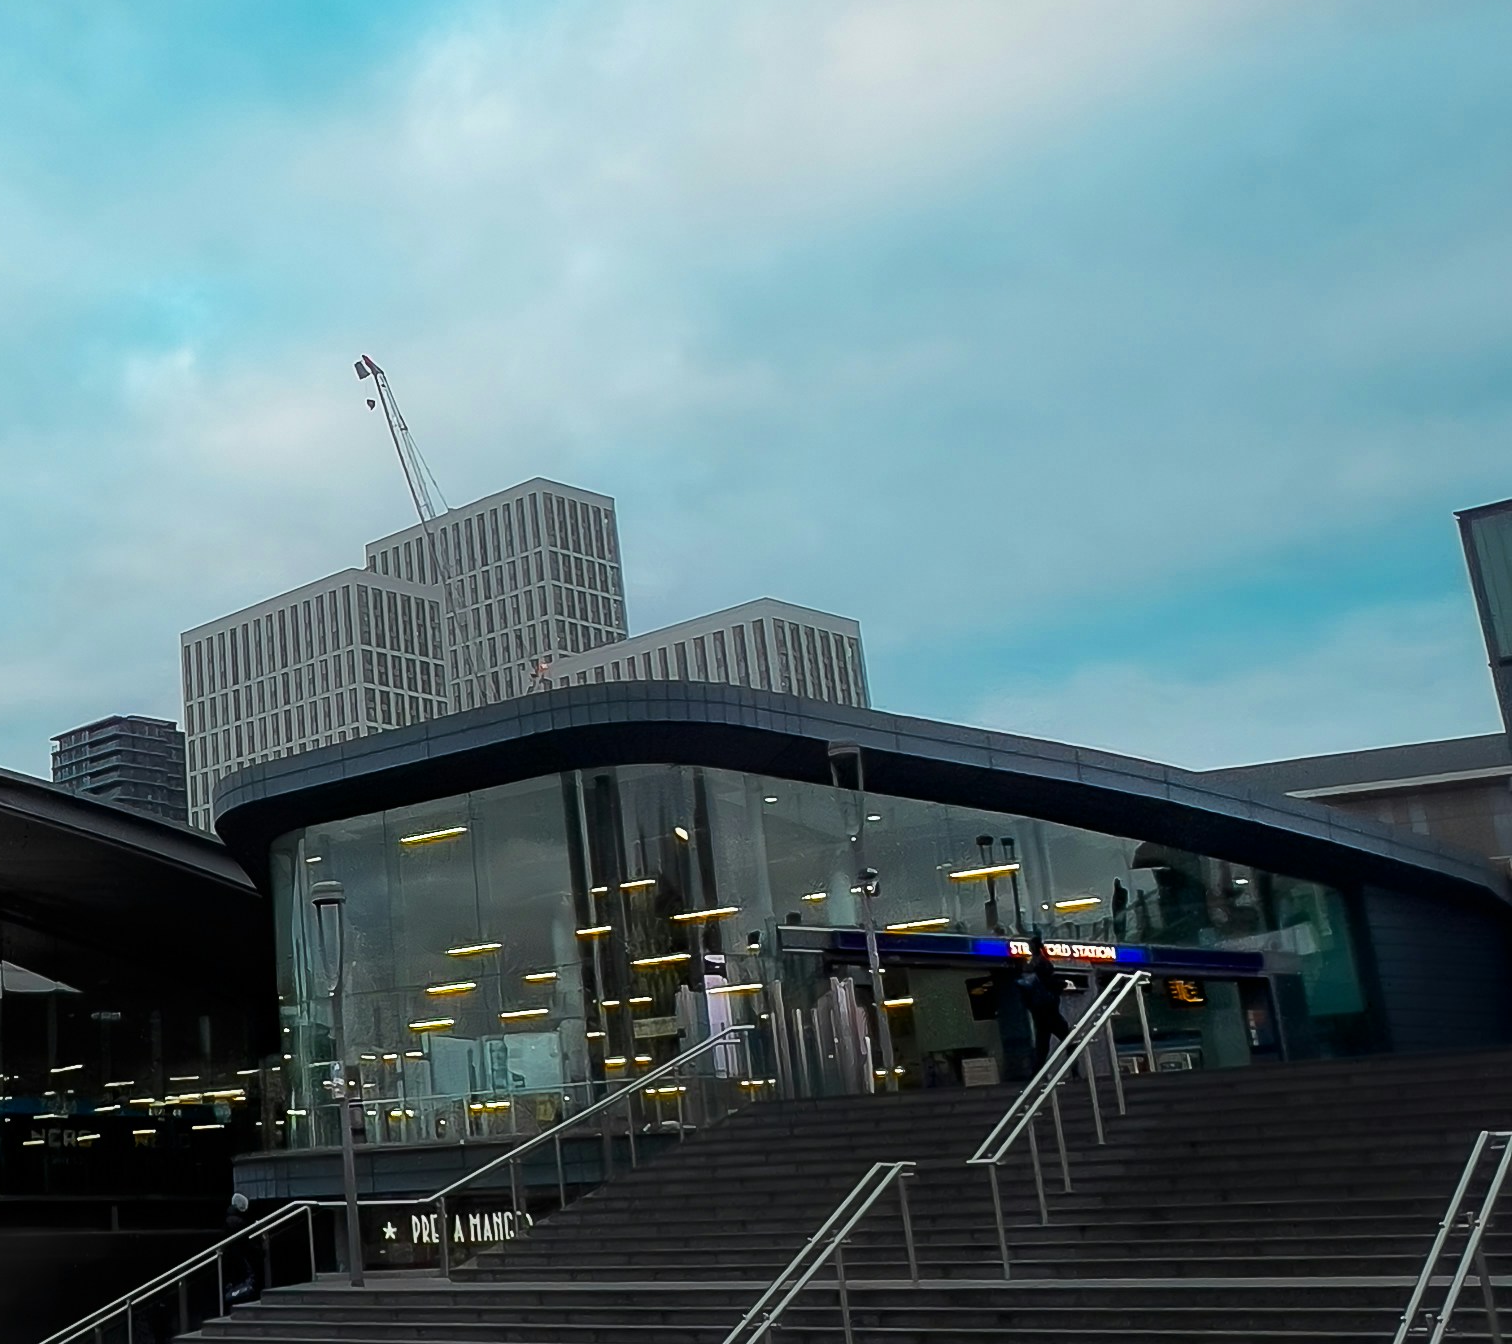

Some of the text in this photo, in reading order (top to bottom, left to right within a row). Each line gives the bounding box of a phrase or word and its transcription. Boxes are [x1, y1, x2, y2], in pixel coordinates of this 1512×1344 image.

[1071, 944, 1116, 959] STATION
[411, 1213, 448, 1244] PRE
[453, 1214, 465, 1243] A
